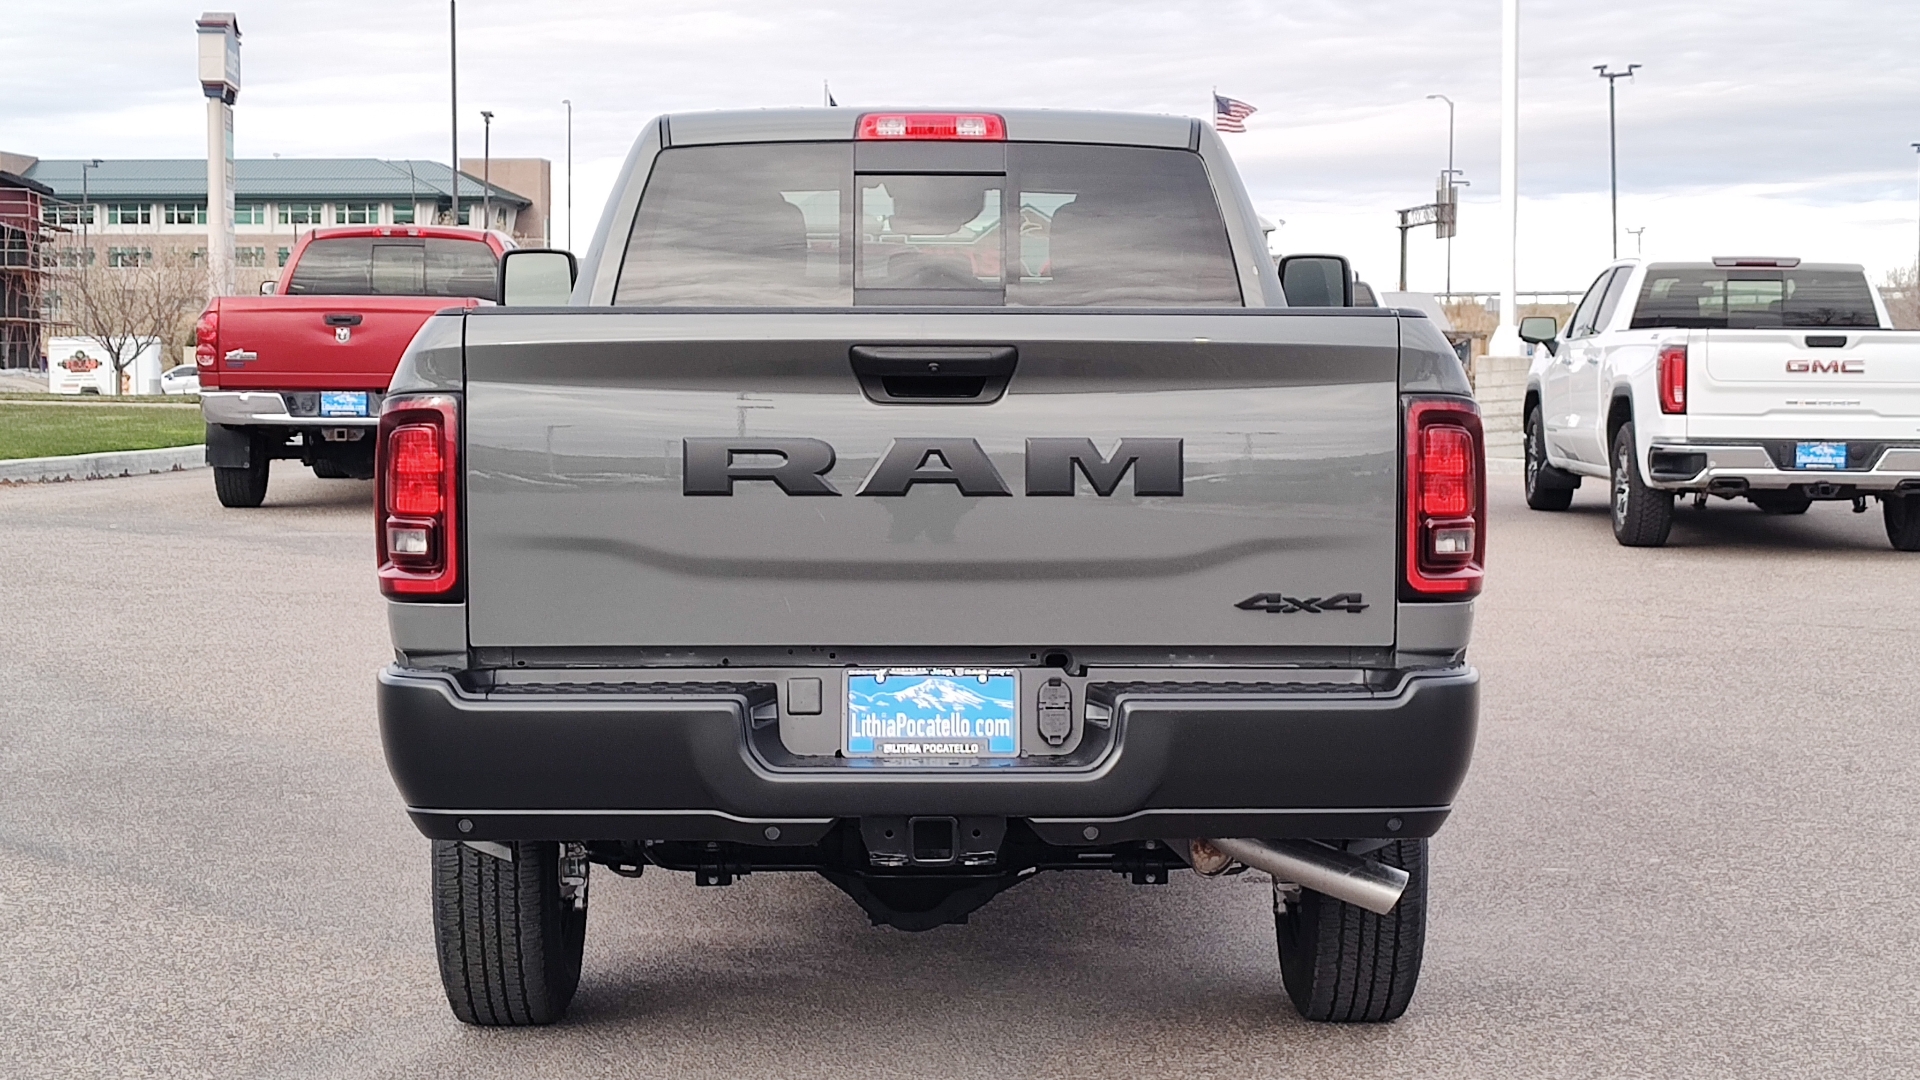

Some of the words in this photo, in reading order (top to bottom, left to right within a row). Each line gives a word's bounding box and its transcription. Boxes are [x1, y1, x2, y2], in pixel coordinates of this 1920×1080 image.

[1785, 359, 1865, 374] GMC
[683, 437, 1184, 497] RAM
[1234, 593, 1370, 613] 4x4
[851, 712, 1010, 737] LithiaPocatello.com
[892, 743, 921, 754] LITHIA
[923, 743, 979, 754] POCATELLO
